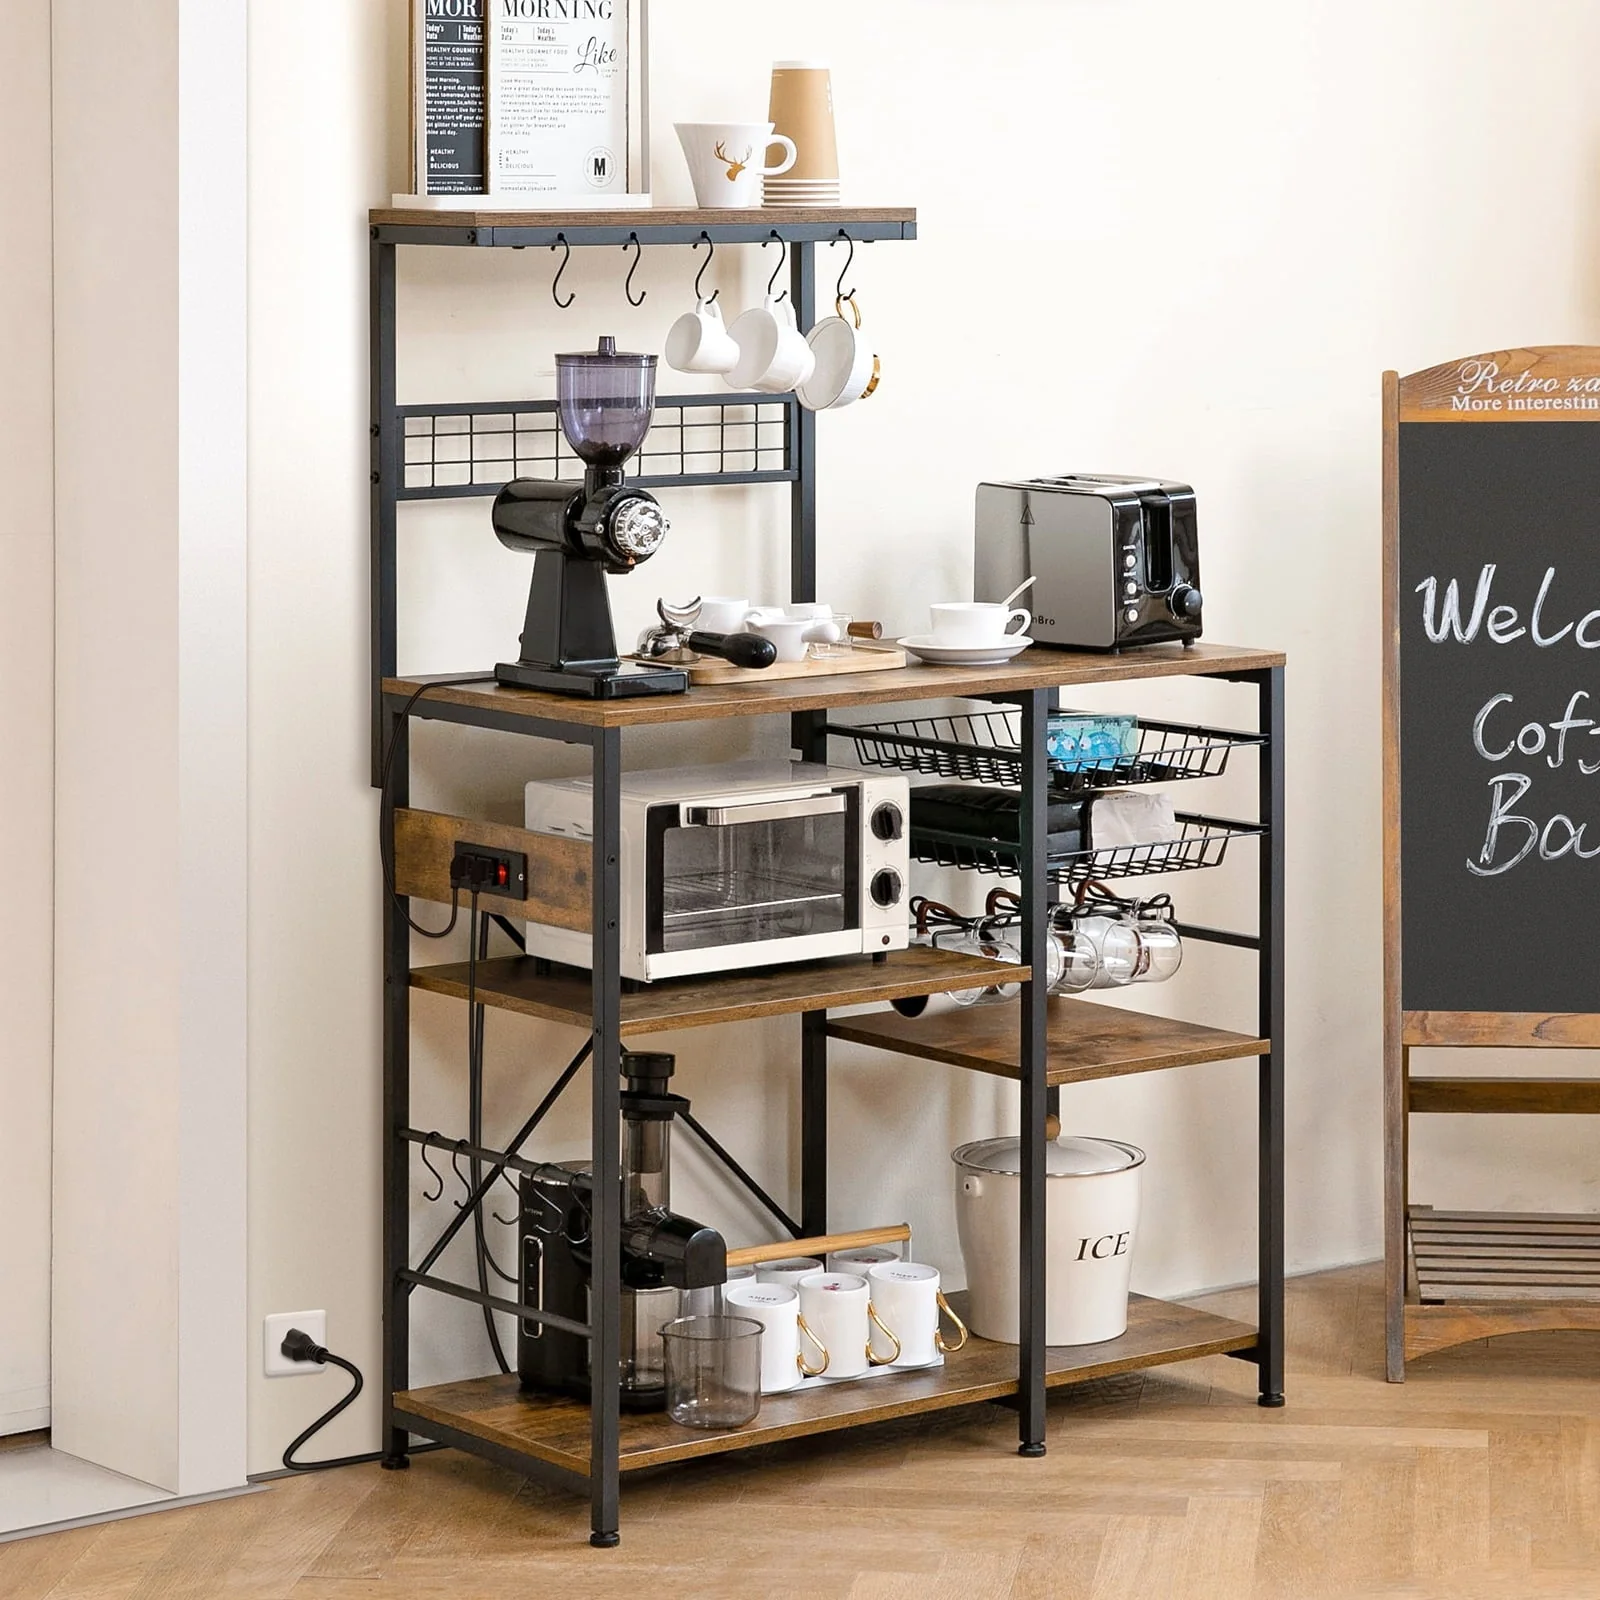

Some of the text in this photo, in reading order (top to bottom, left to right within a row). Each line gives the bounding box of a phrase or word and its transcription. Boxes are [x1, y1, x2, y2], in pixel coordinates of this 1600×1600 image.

[426, 0, 483, 17] MOR
[500, 0, 612, 20] MORNING
[451, 46, 478, 54] GOURMET
[573, 36, 618, 75] Like
[594, 157, 606, 176] M
[1456, 359, 1560, 394] Retro
[1451, 394, 1600, 411] More interestin
[1073, 1230, 1130, 1261] ICE
